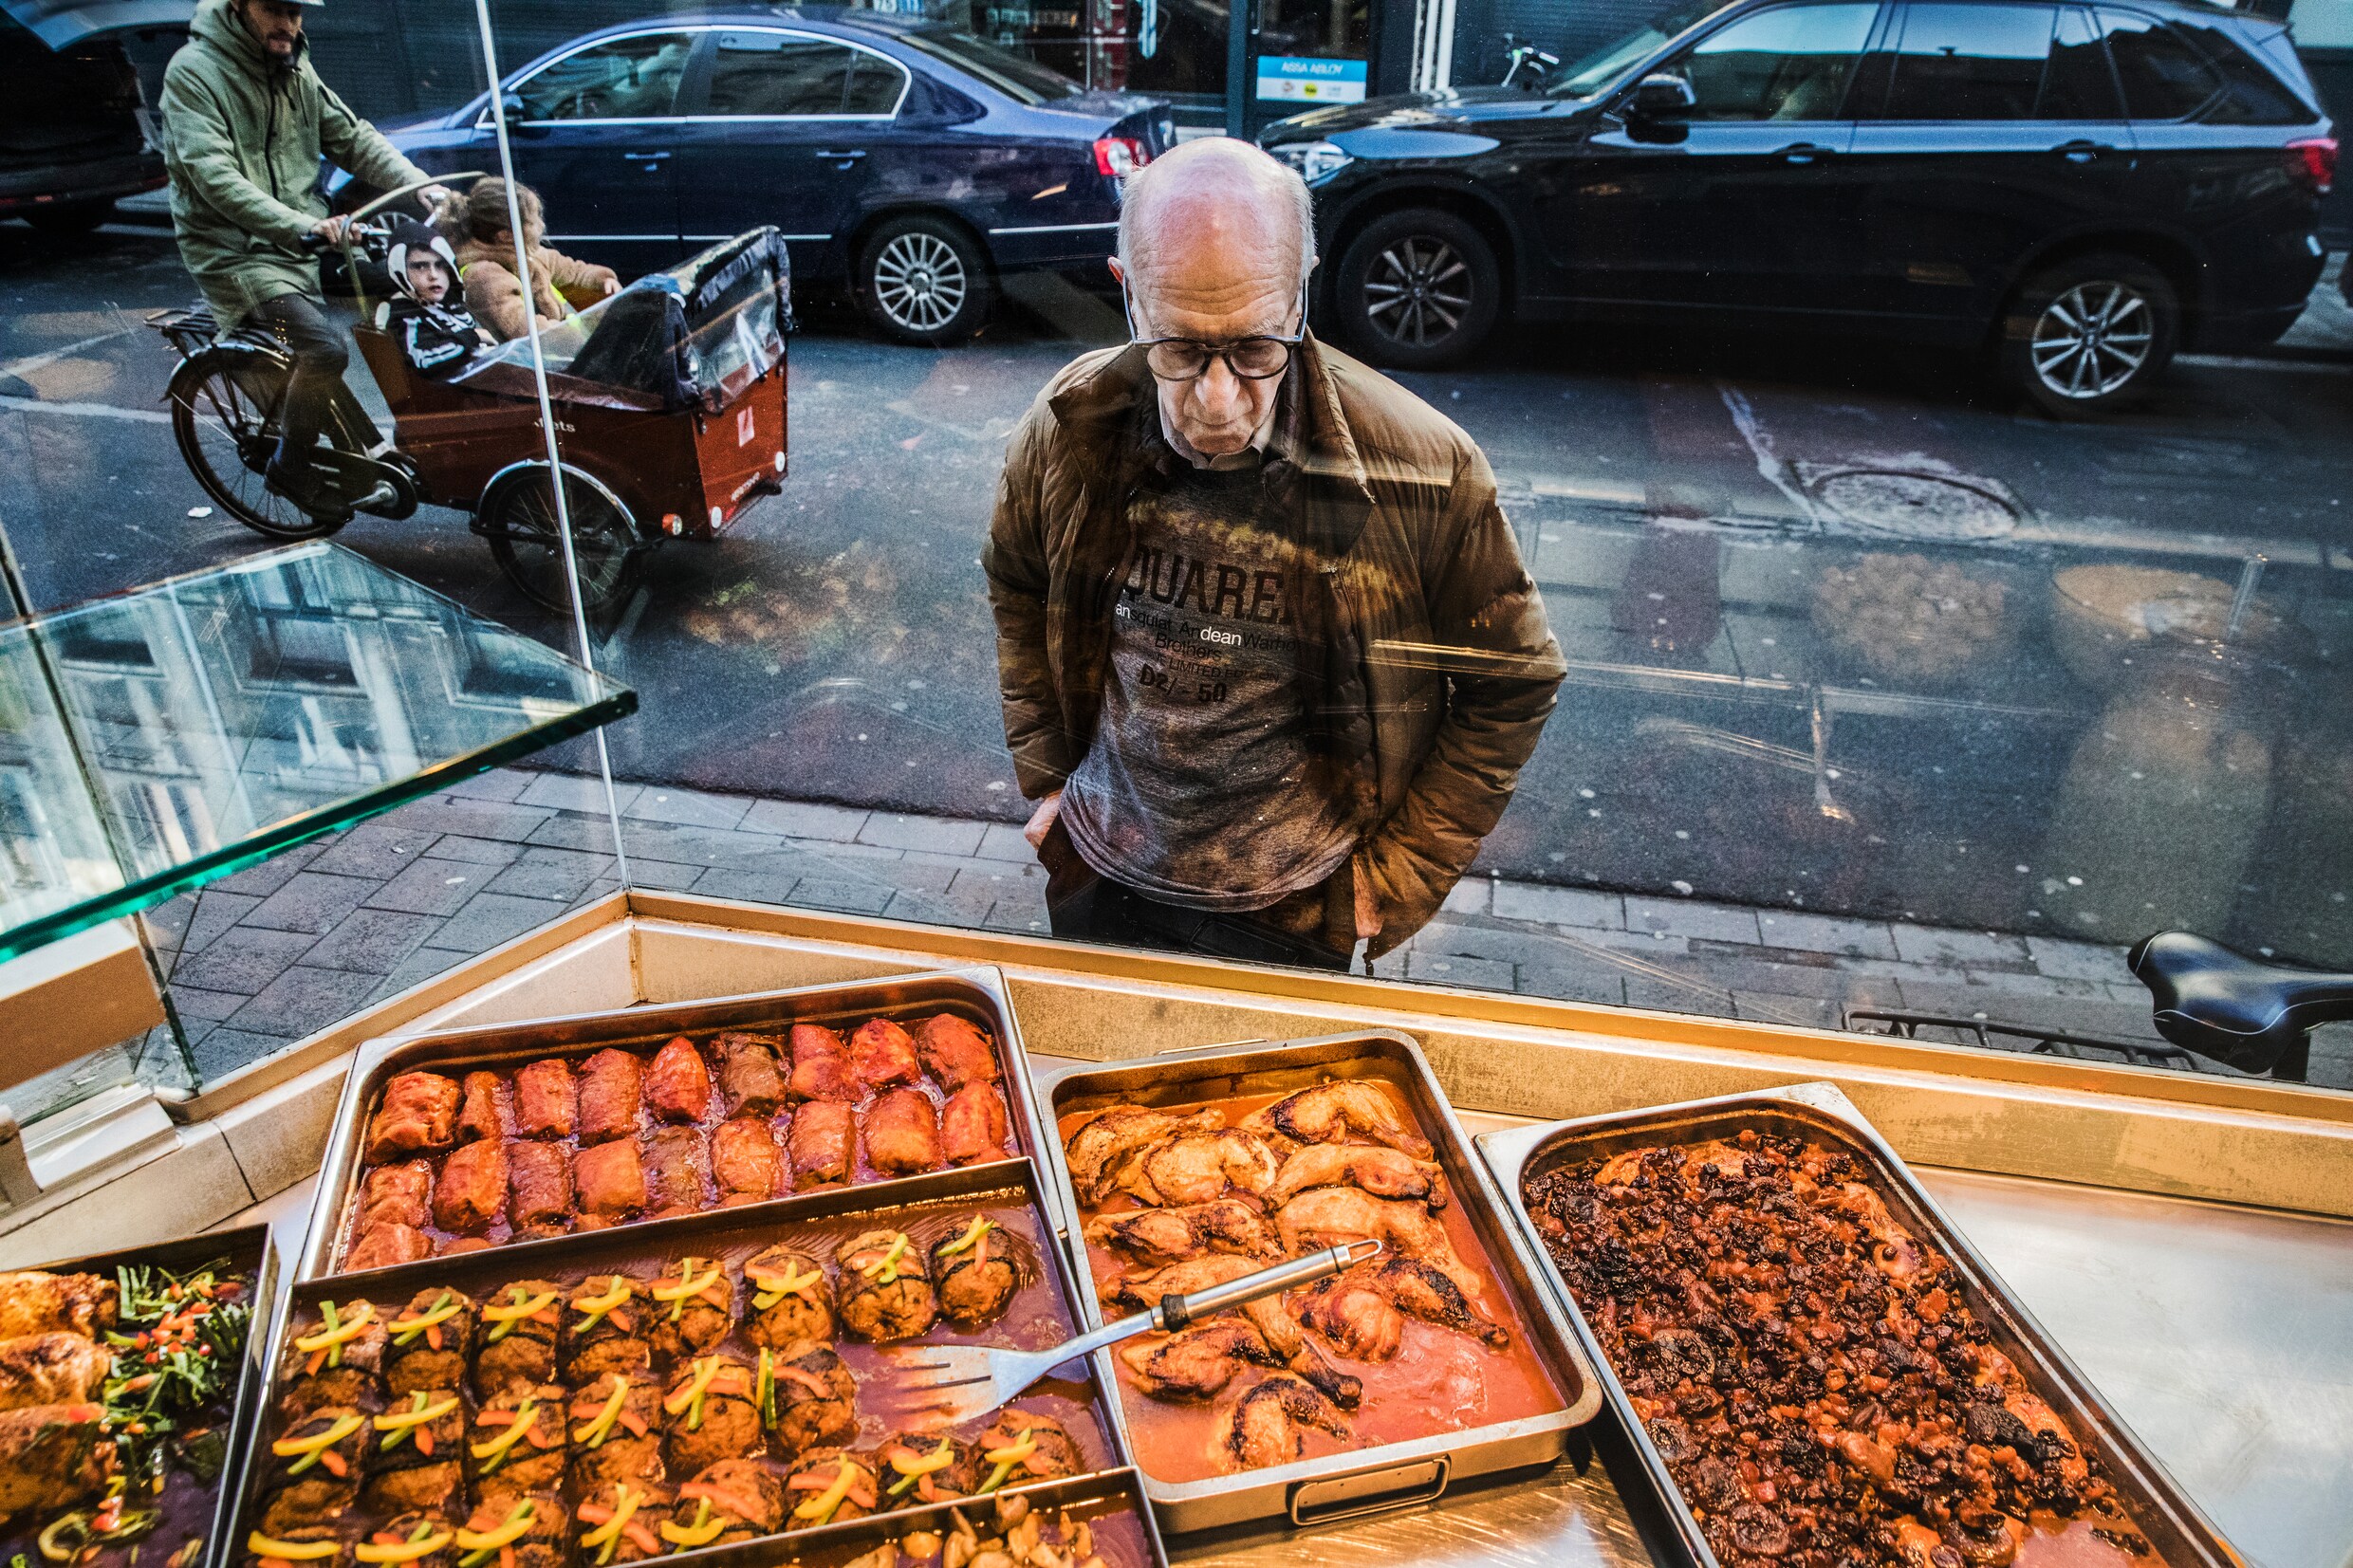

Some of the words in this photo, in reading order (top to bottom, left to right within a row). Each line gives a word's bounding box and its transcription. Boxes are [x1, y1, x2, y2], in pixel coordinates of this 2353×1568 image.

[1281, 62, 1308, 73] ASSA
[1309, 63, 1343, 75] ABLOY
[1122, 544, 1291, 624] QUARE
[1155, 633, 1223, 662] Brothers
